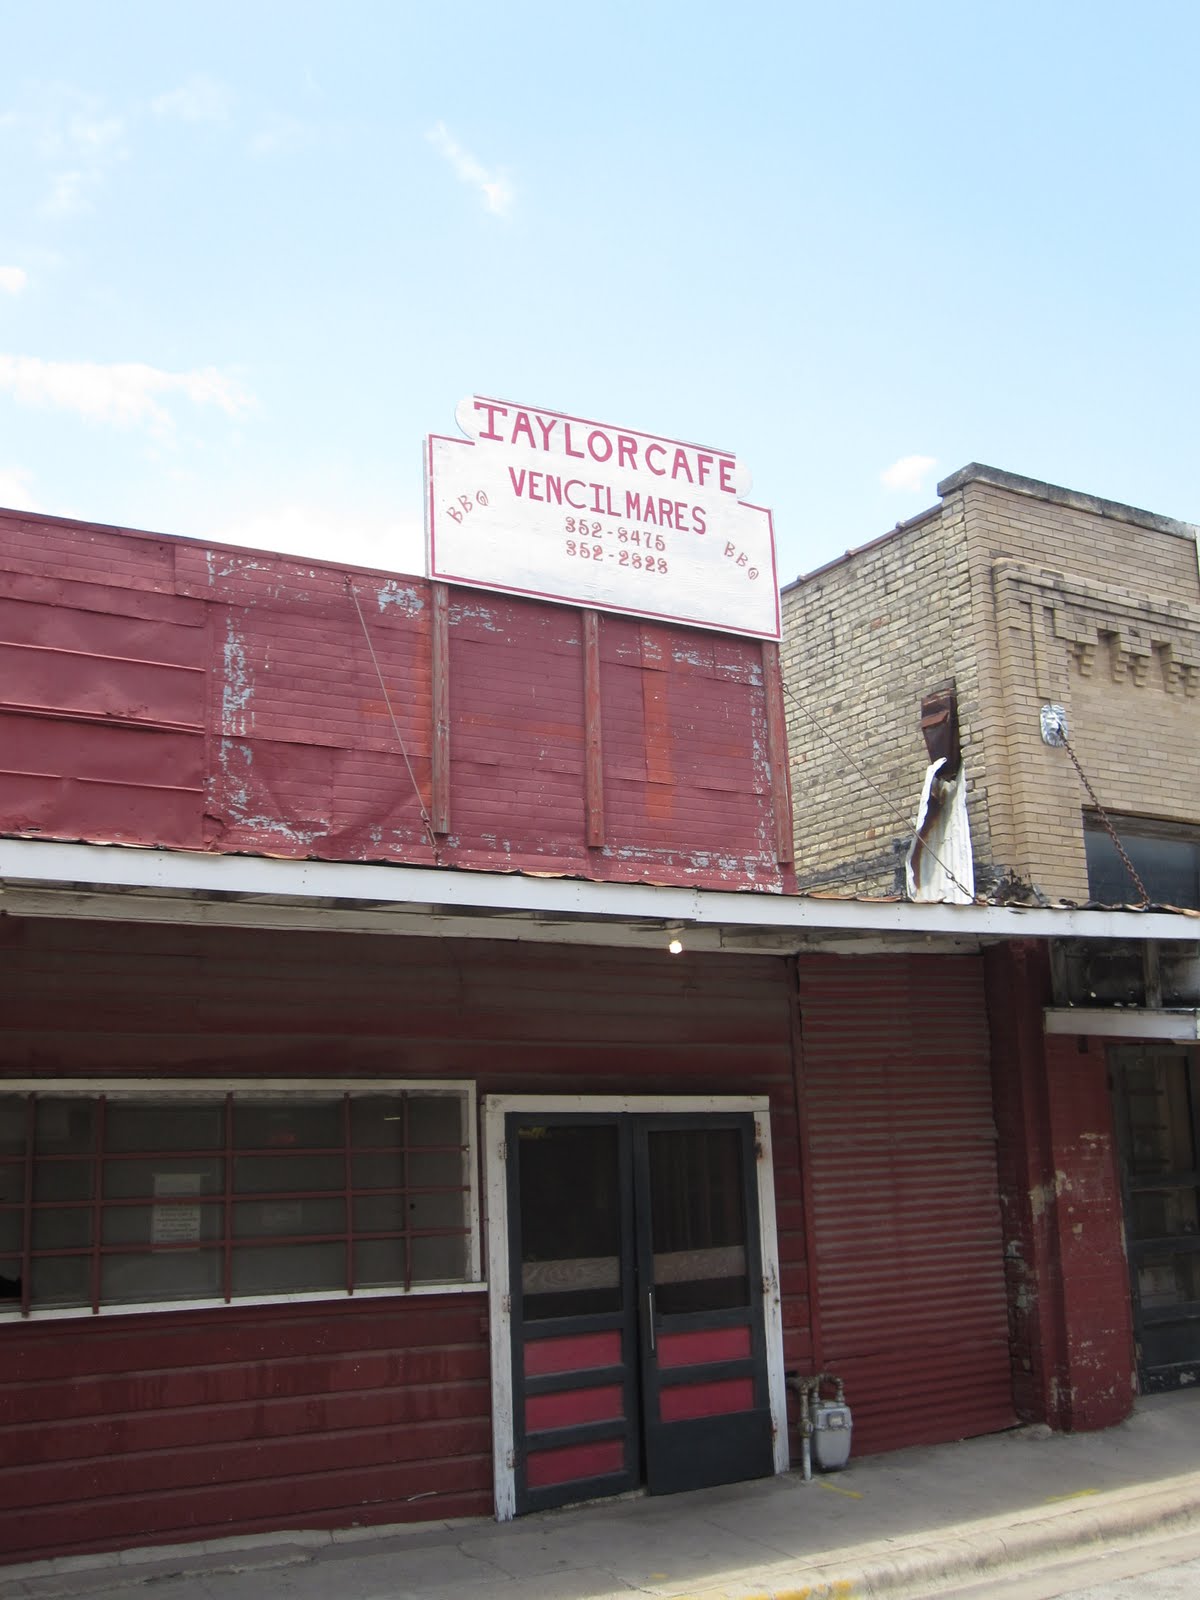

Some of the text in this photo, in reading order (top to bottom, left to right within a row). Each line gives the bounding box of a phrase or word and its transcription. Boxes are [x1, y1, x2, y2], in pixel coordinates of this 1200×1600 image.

[446, 489, 489, 524] BBQ
[565, 516, 666, 552] 352-8475
[566, 540, 668, 575] 352-2828
